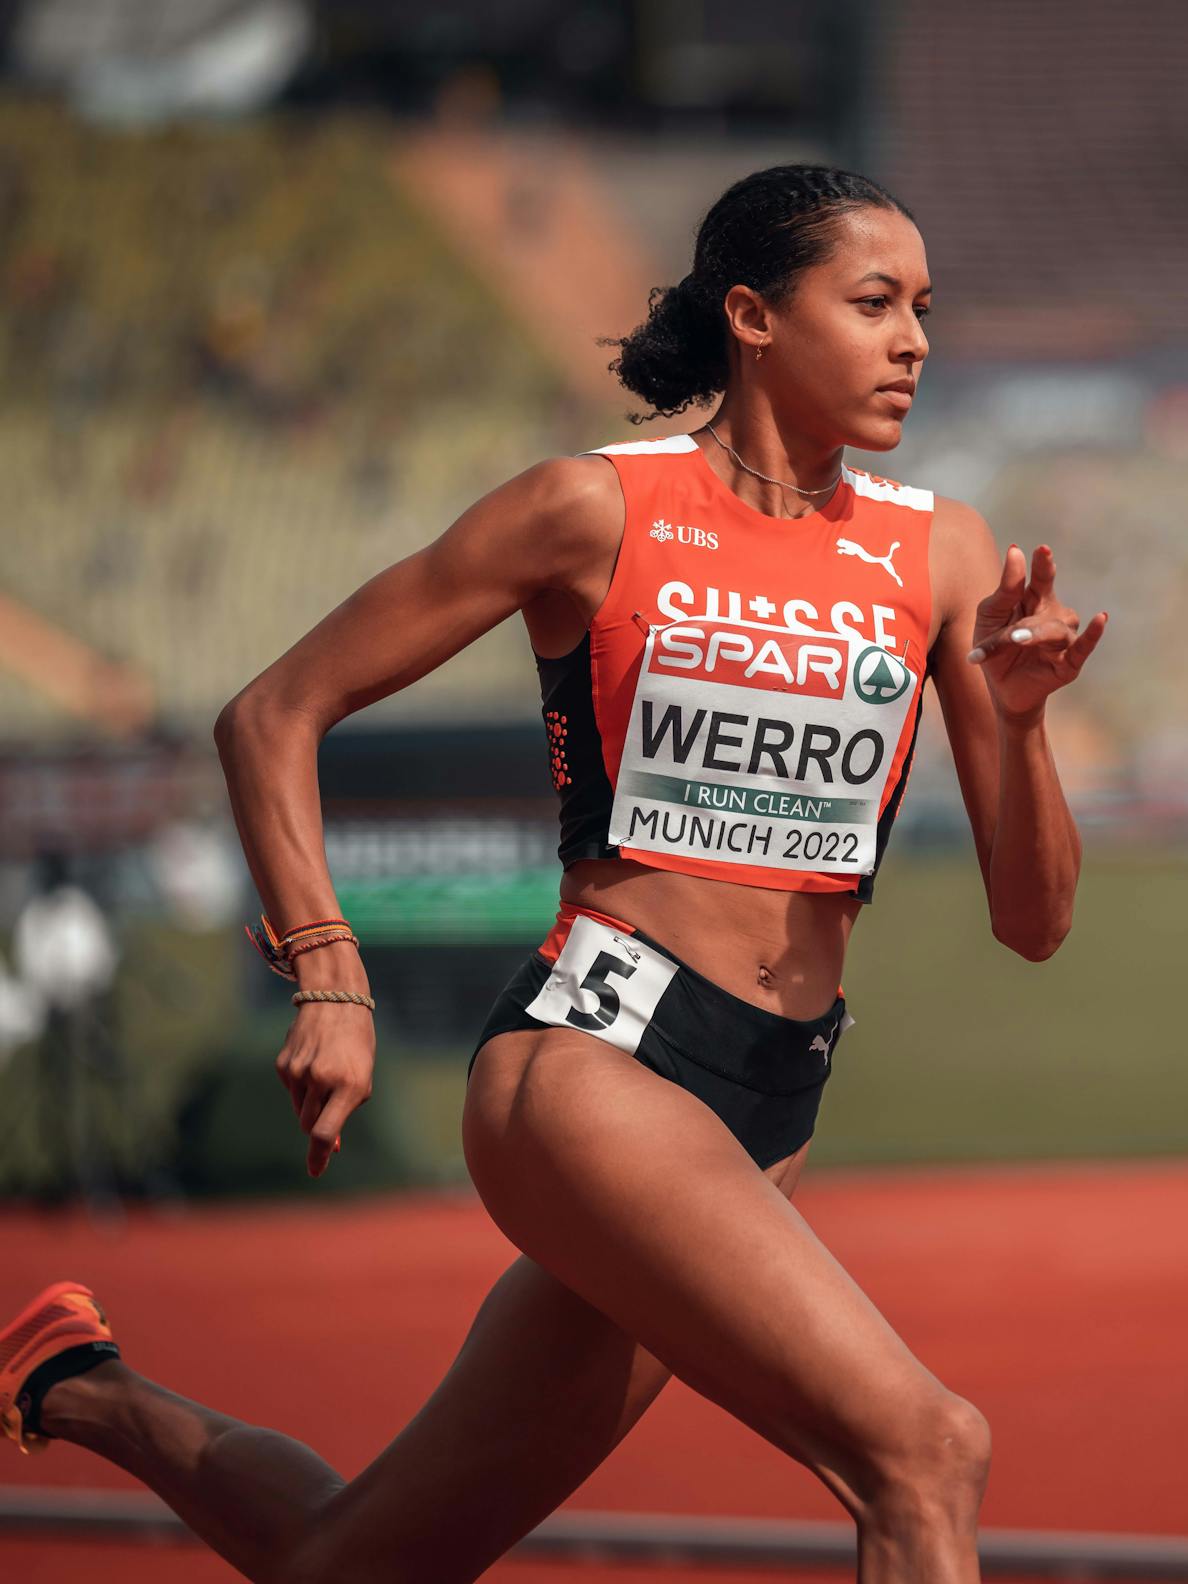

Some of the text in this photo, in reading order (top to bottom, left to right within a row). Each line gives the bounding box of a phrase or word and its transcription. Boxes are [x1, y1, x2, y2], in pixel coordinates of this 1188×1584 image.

[676, 525, 719, 550] UBS
[657, 626, 844, 691] SPAR
[641, 699, 885, 785] WERRO
[684, 783, 691, 802] I
[697, 785, 747, 811] RUN
[629, 806, 860, 863] MUNICH 2022
[565, 950, 638, 1032] 5
